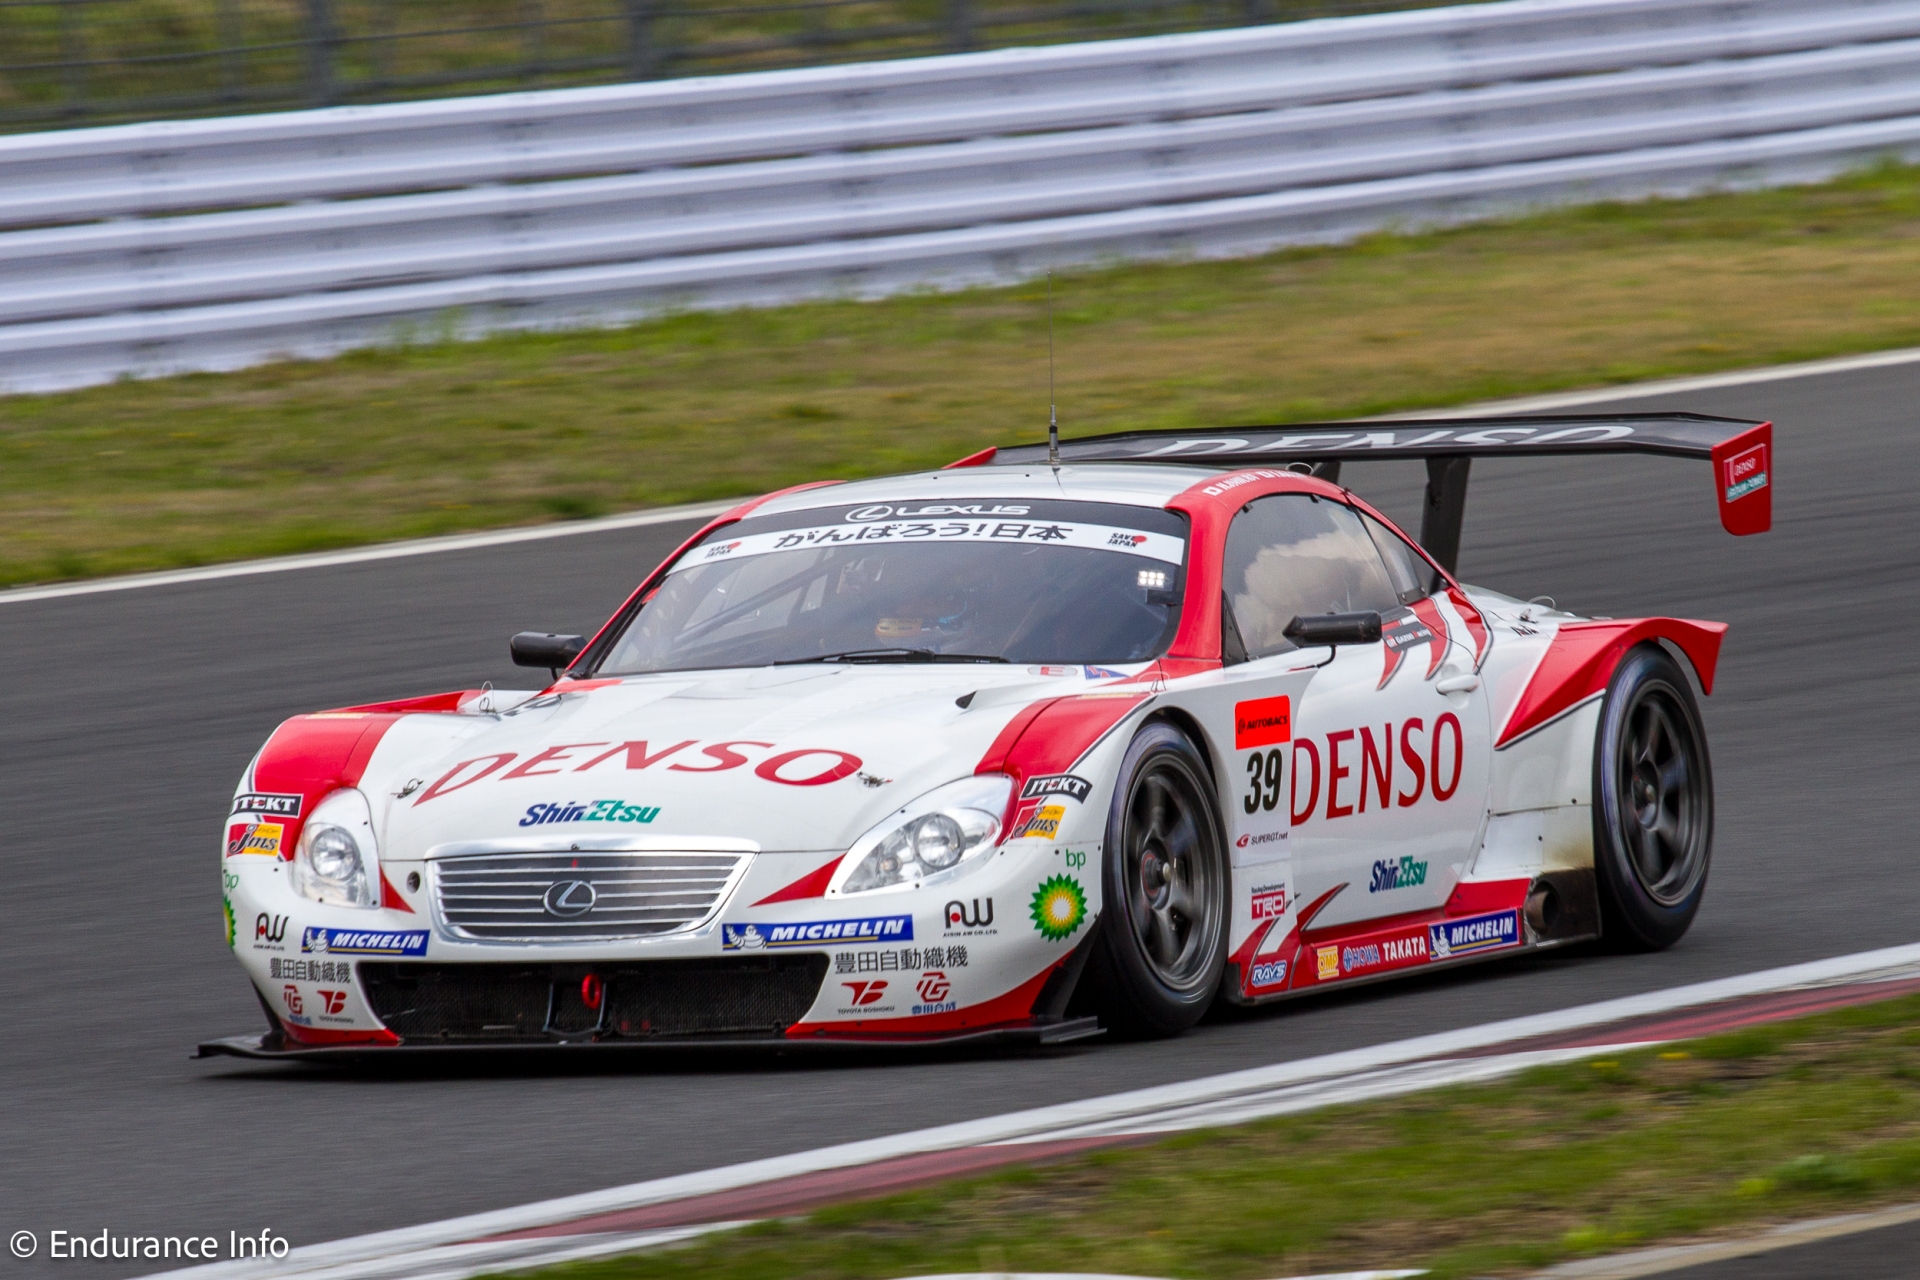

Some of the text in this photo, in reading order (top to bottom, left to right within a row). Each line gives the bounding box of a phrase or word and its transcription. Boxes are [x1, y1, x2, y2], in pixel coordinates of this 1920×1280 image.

[1137, 426, 1636, 457] DENSO
[895, 505, 1030, 517] LEXUS
[772, 521, 1073, 549] がんばろう!日本
[1107, 538, 1138, 547] JAPAN
[1246, 715, 1288, 730] AUTOBACS
[411, 740, 864, 808] DENSO
[1290, 711, 1463, 827] DENSO
[1026, 777, 1087, 796] JTEKT
[1244, 748, 1282, 814] 39
[230, 796, 296, 814] JTEKT
[1065, 848, 1087, 870] bp
[1253, 895, 1284, 918] TRD
[332, 932, 425, 949] MICHELIN
[770, 919, 904, 941] MICHELIN
[1451, 917, 1513, 945] MICHELIN
[1383, 936, 1426, 962] TAKATA
[1253, 964, 1286, 982] RAYS
